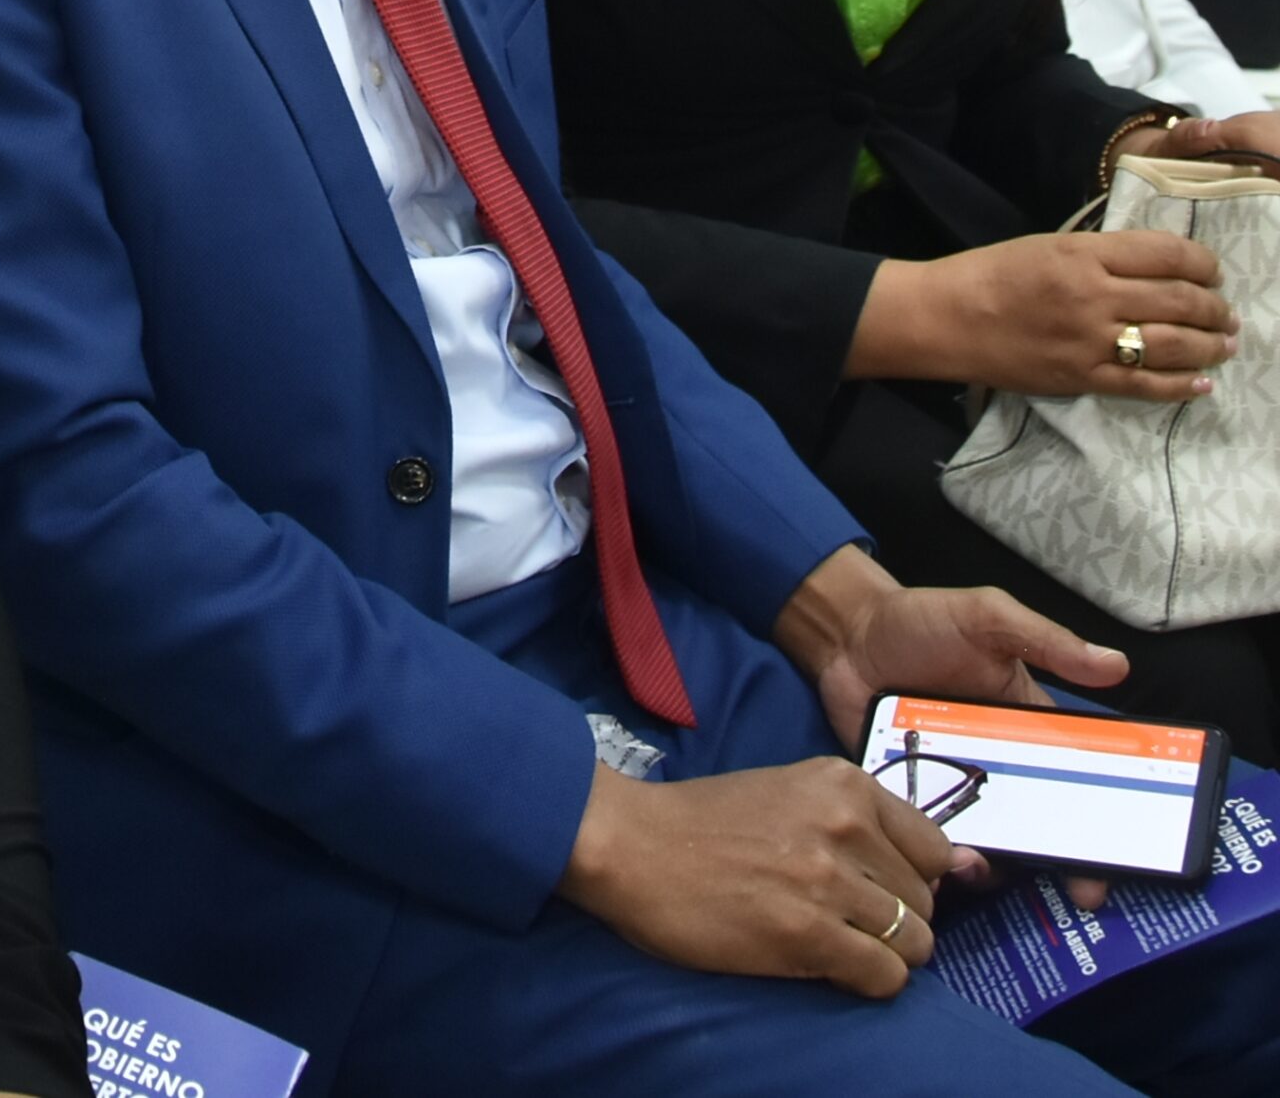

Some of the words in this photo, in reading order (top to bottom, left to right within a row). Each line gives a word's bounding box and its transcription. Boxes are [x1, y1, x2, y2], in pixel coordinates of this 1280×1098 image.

[1218, 807, 1262, 874] OBIERNO
[1224, 797, 1272, 832] ¿QUÉ
[1251, 828, 1277, 847] ES
[1035, 873, 1072, 929] GOBIERNO
[1062, 929, 1097, 976] ABIERTO
[1084, 920, 1106, 944] DEL
[87, 1039, 204, 1098] OBIERNO
[145, 1032, 181, 1063] ES
